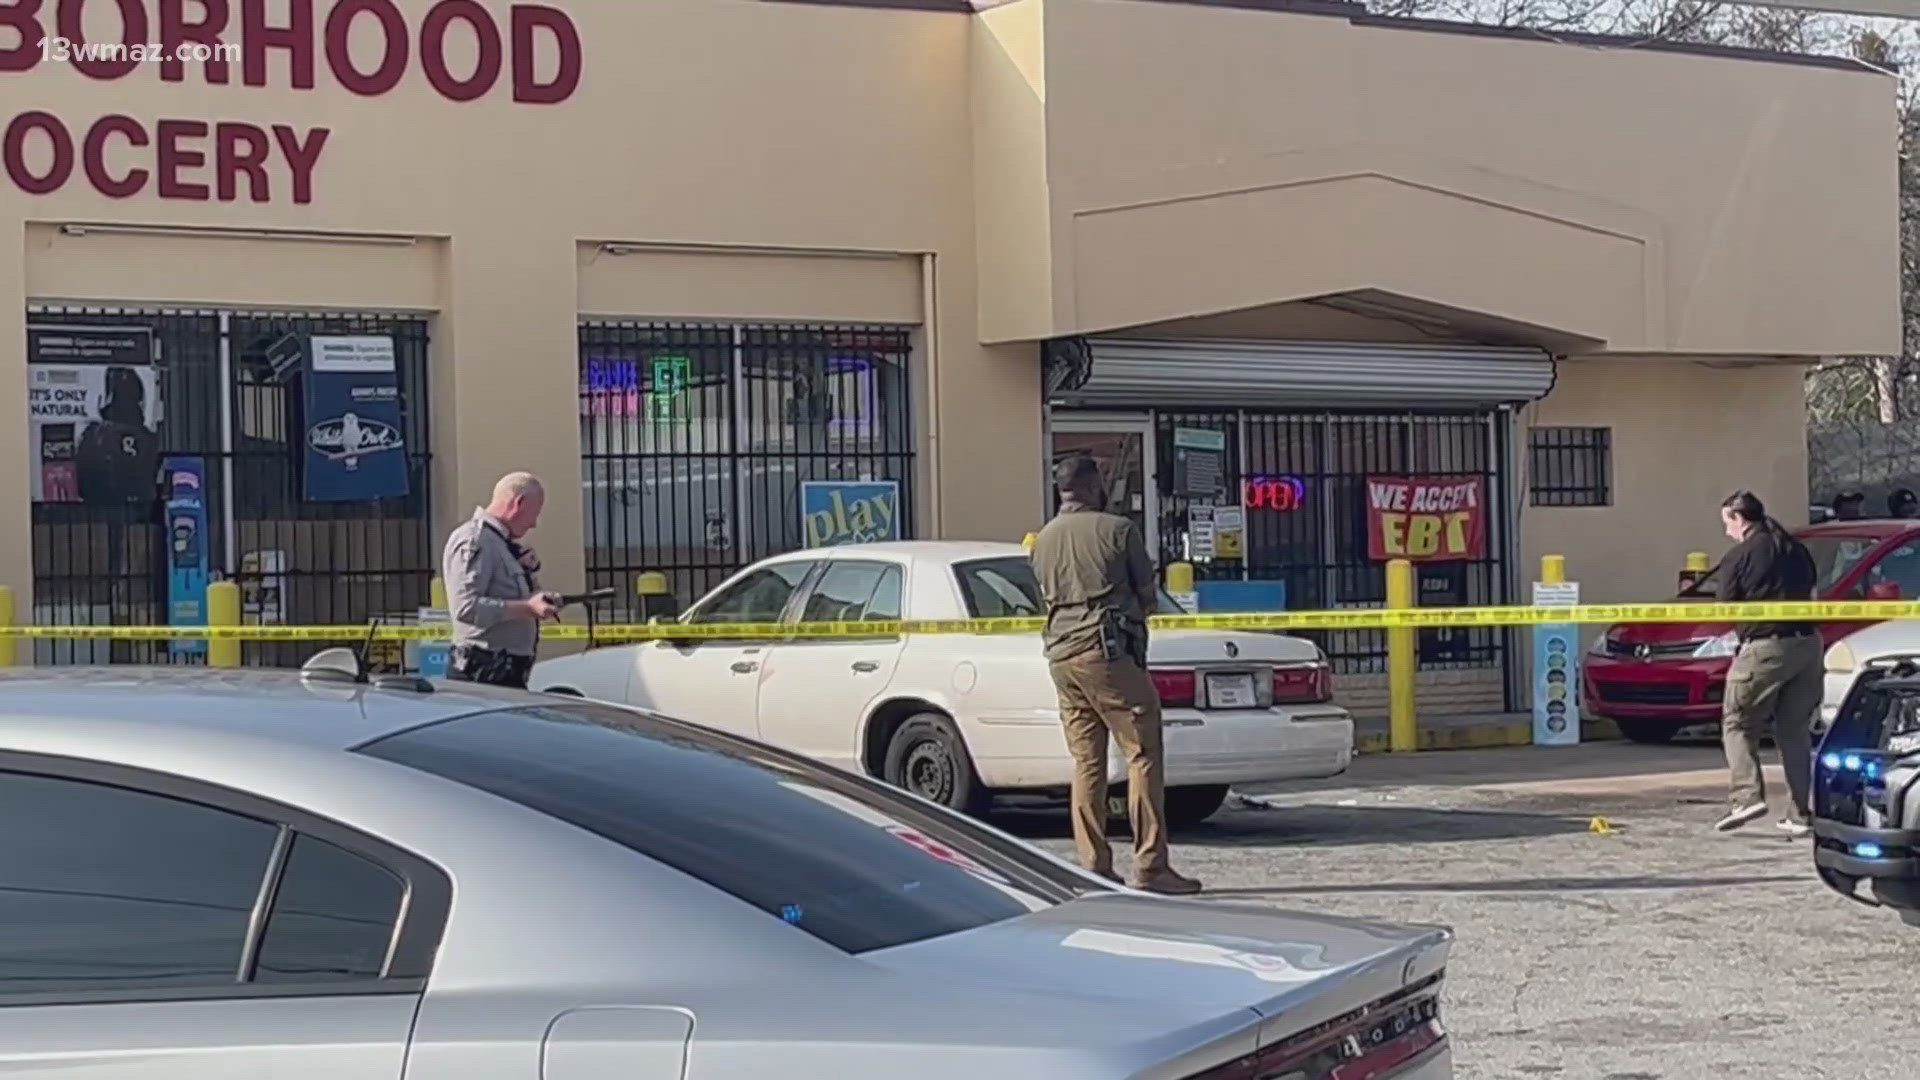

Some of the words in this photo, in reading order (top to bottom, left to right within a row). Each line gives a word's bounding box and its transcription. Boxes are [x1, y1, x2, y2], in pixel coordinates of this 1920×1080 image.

[3, 110, 330, 204] OCERY
[31, 403, 88, 417] NATURAL
[54, 389, 88, 402] ONLY
[1368, 481, 1409, 510] WE
[1410, 481, 1478, 512] ACCEPT
[806, 489, 896, 548] play
[1381, 511, 1470, 556] EBT
